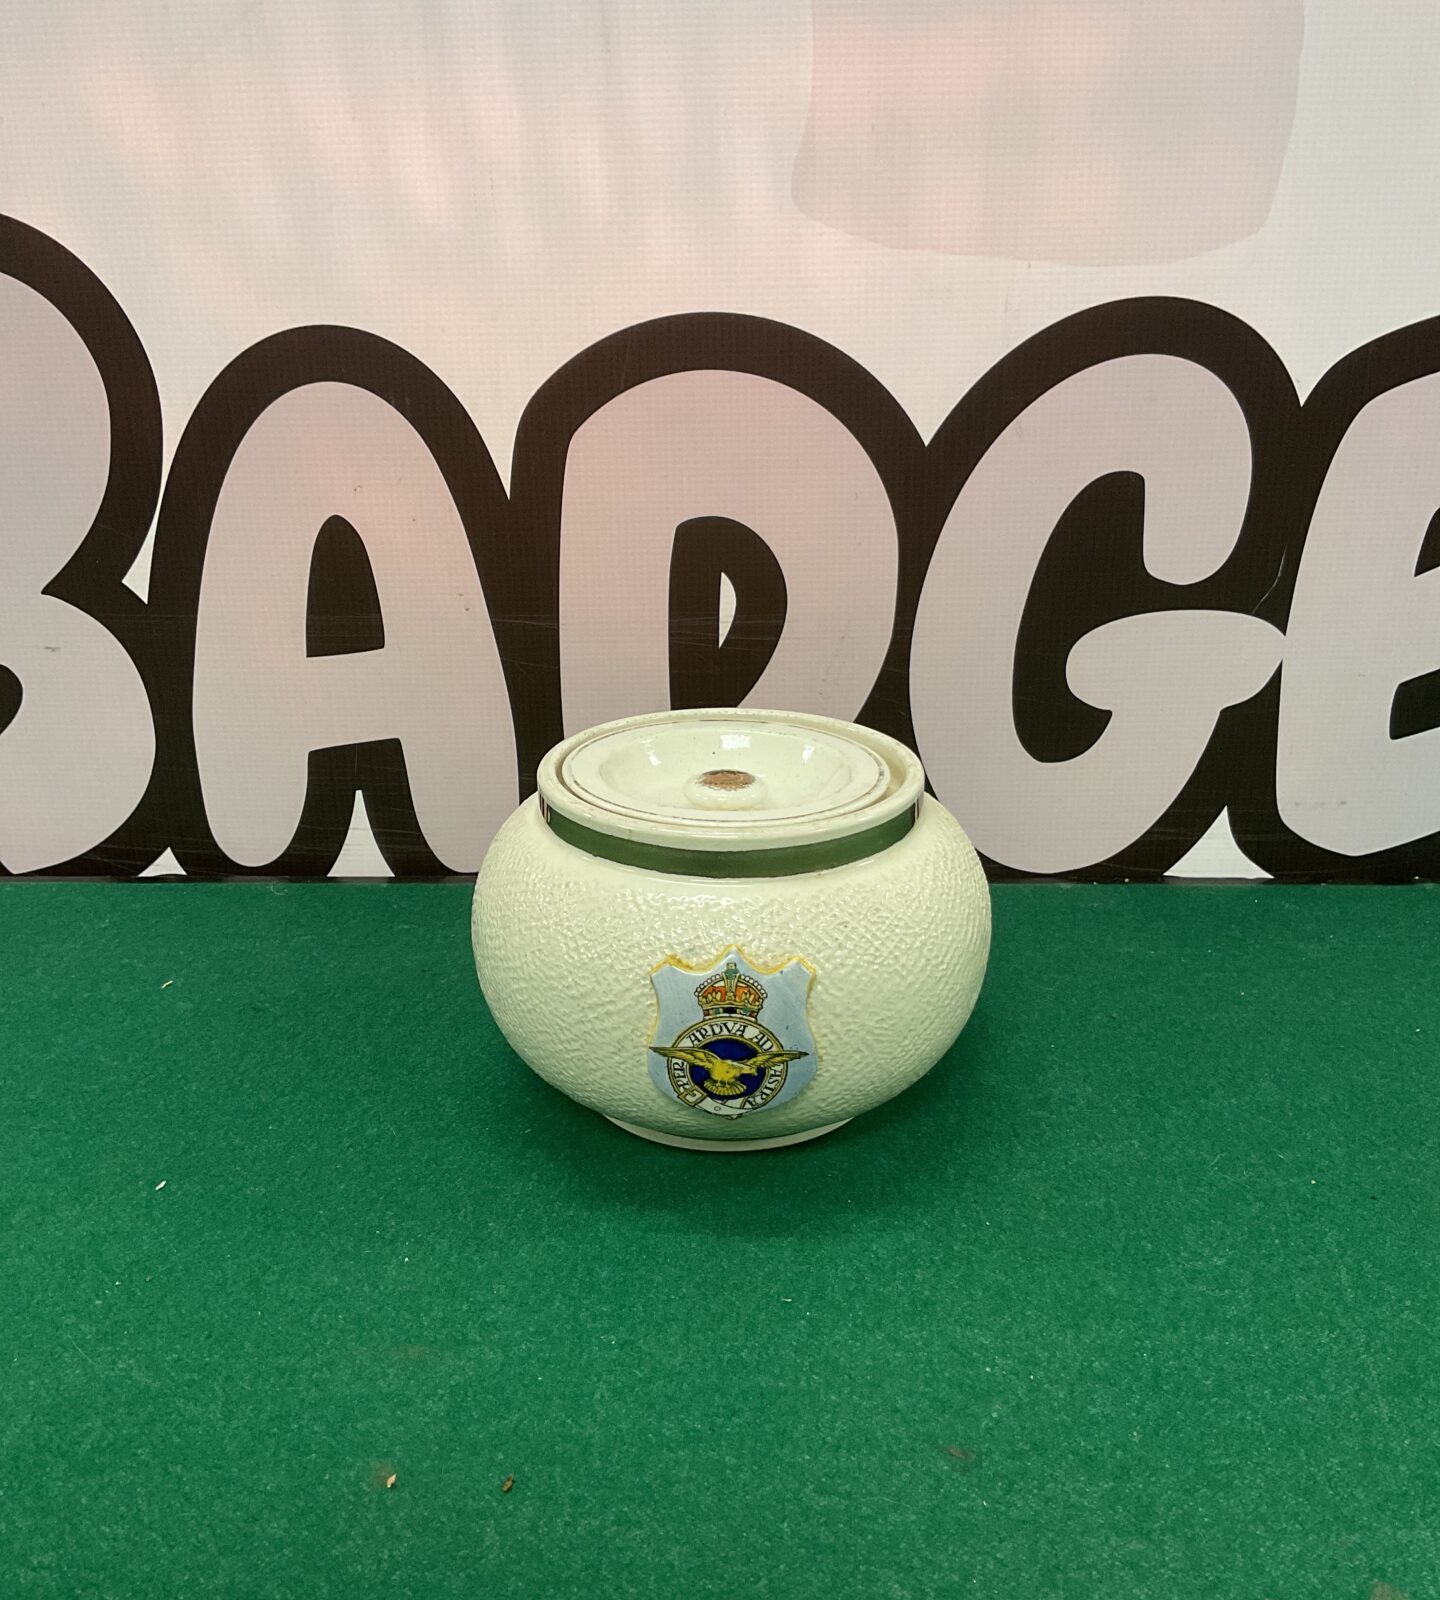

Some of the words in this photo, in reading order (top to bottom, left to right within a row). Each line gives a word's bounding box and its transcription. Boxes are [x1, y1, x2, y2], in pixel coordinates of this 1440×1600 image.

[672, 1060, 688, 1092] PER
[686, 1021, 748, 1047] ARDVA
[751, 1031, 775, 1052] AD
